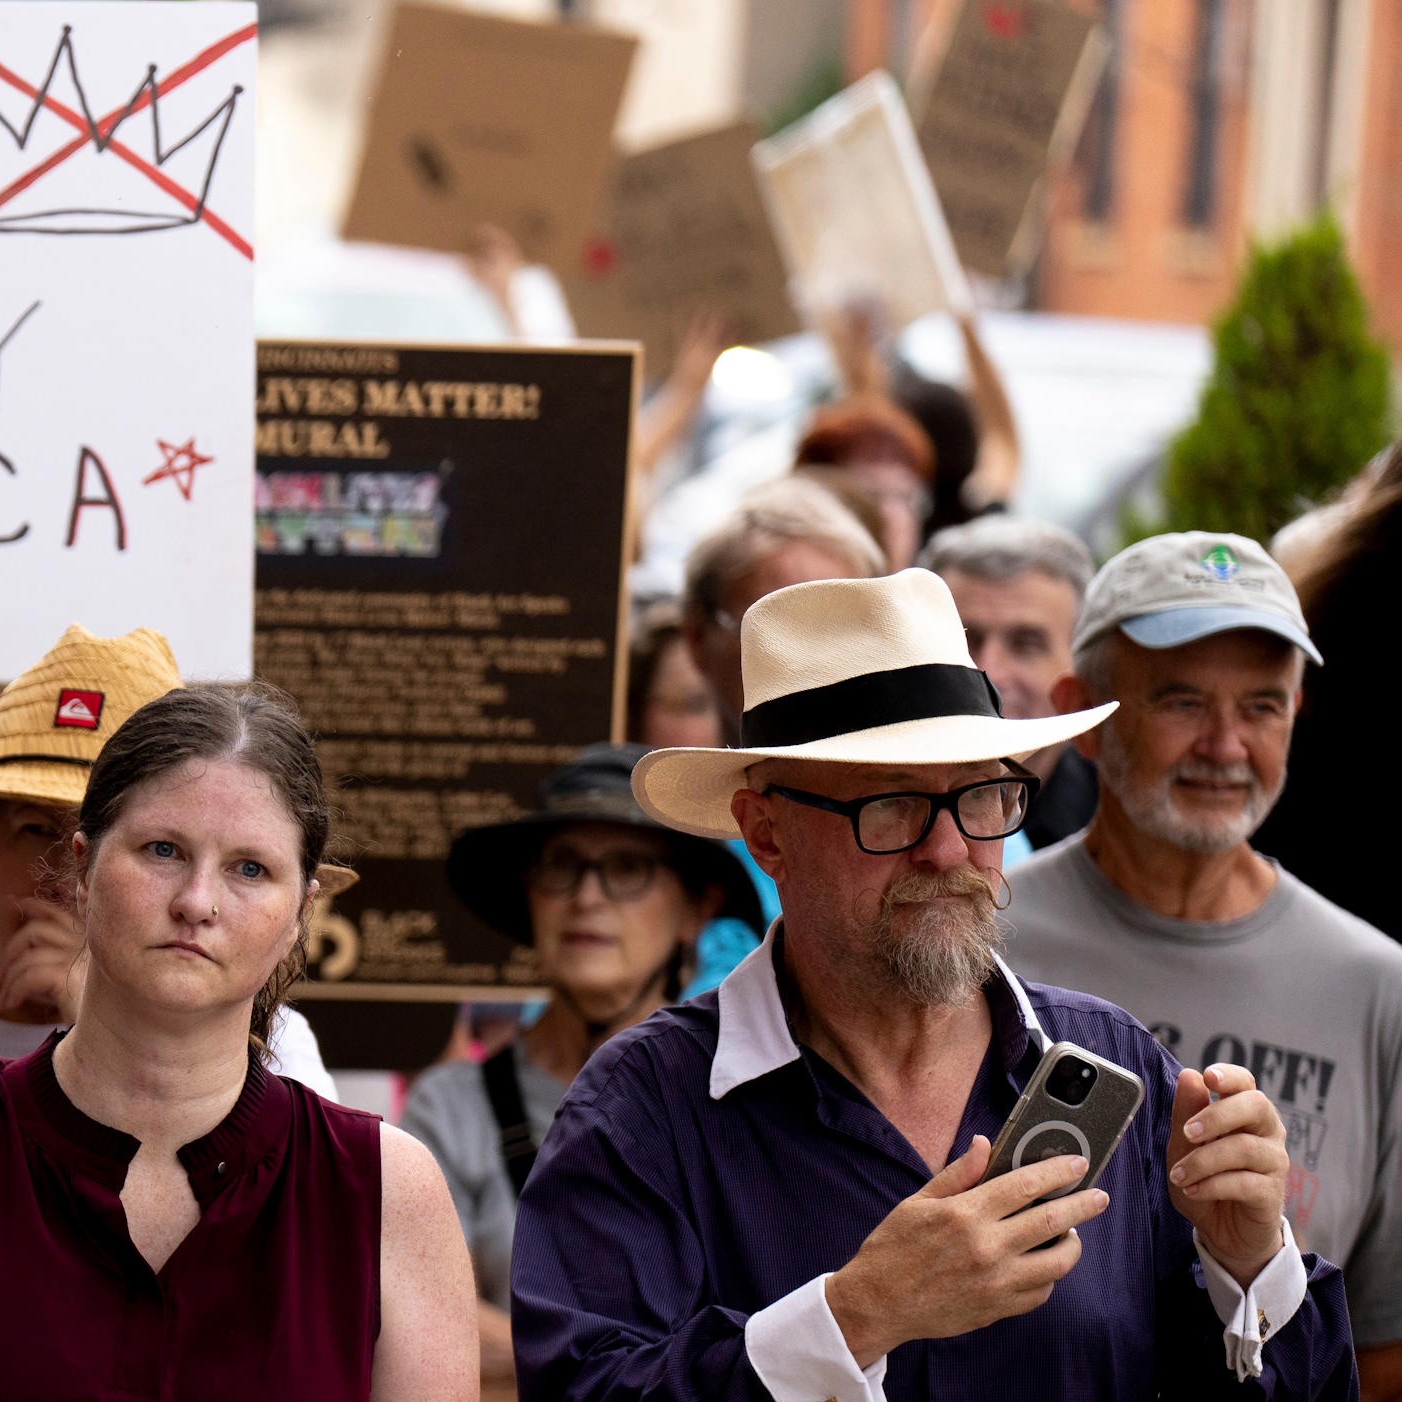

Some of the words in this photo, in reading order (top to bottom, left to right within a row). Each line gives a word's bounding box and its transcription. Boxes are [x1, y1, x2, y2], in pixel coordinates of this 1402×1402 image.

[256, 378, 358, 416] IVES
[362, 380, 541, 420] MATTER!
[1201, 1032, 1336, 1113] OFF!
